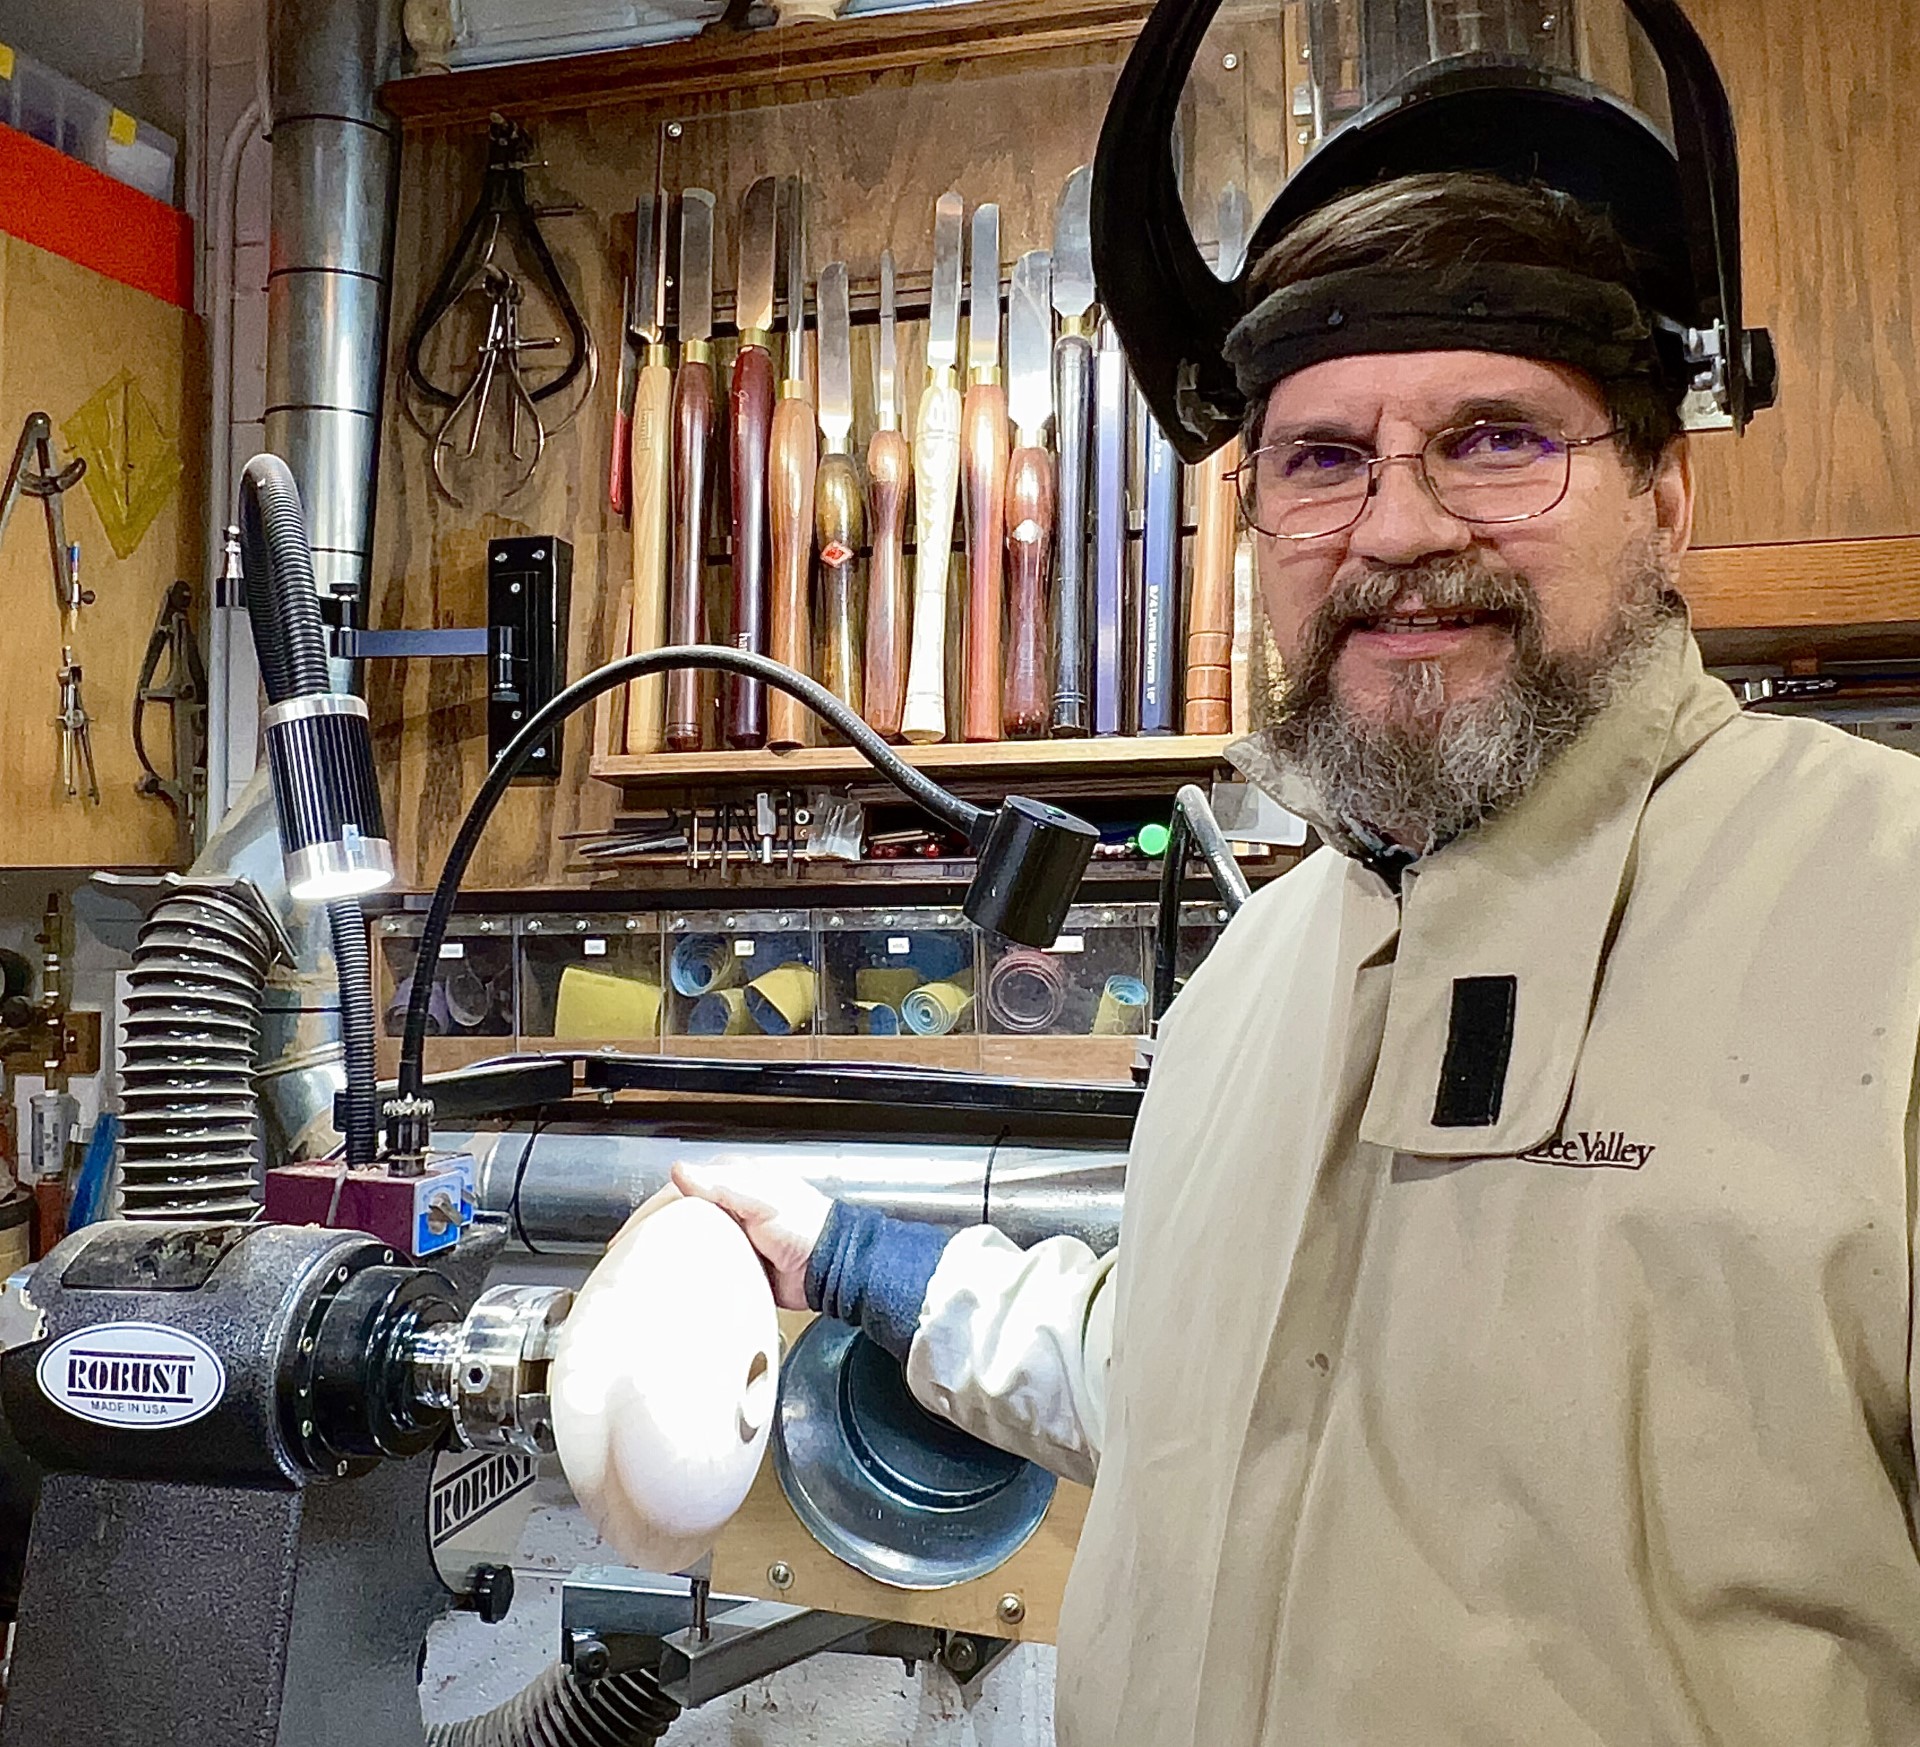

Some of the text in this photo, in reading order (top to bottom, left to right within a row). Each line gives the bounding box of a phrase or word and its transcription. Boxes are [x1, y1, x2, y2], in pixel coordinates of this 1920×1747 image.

[1578, 1131, 1656, 1169] Valley
[67, 1359, 194, 1395] ROBUST
[90, 1400, 169, 1415] MADE IN USA
